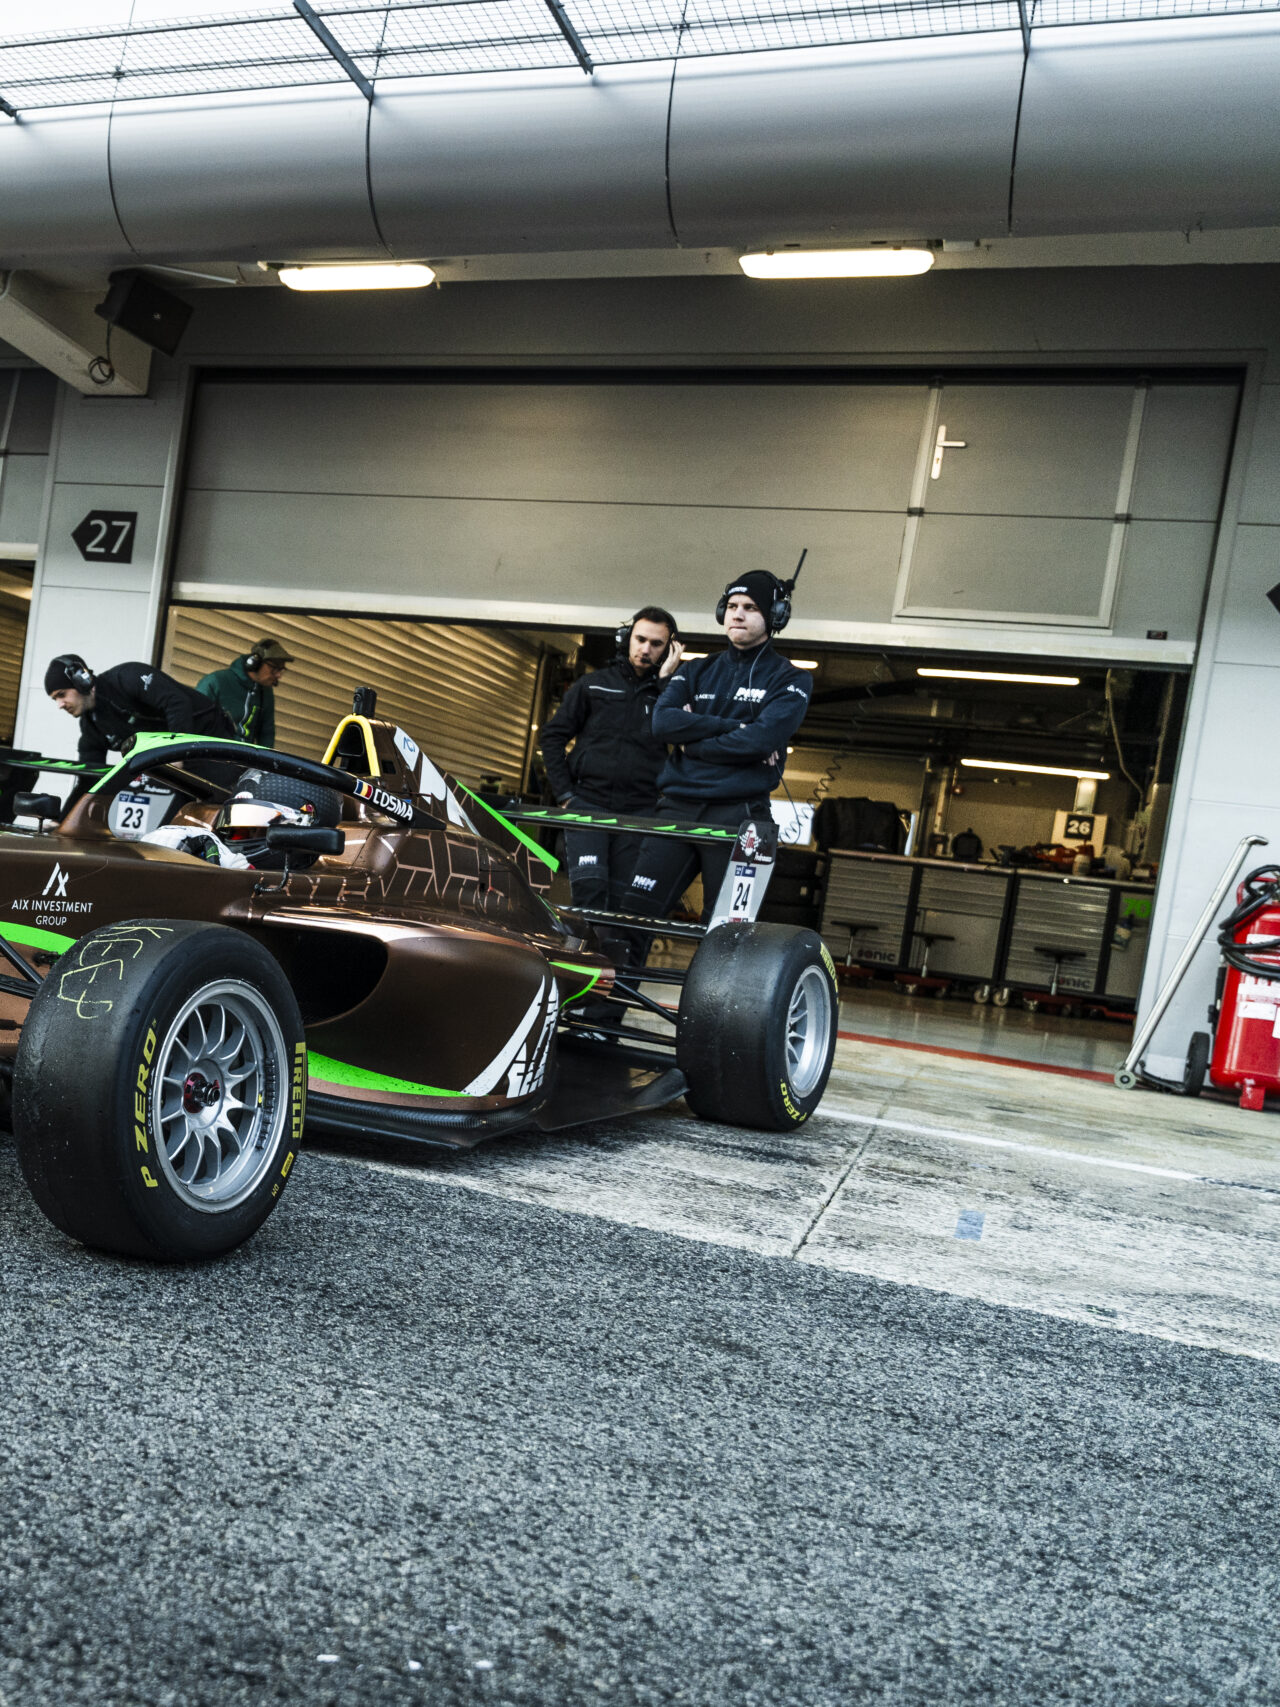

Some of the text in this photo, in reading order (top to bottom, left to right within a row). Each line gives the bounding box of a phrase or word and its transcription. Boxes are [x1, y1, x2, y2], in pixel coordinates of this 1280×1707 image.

[86, 519, 132, 554] 27
[121, 807, 144, 829] 23
[372, 788, 414, 821] COSMA
[1067, 820, 1091, 835] 26
[11, 899, 93, 913] AIX INVESTMENT
[733, 882, 751, 911] 24
[35, 915, 67, 926] GROUP
[134, 1027, 157, 1153] ZERO
[292, 1042, 307, 1139] PIRELLI
[780, 1083, 797, 1121] ZERO
[140, 1166, 158, 1188] P
